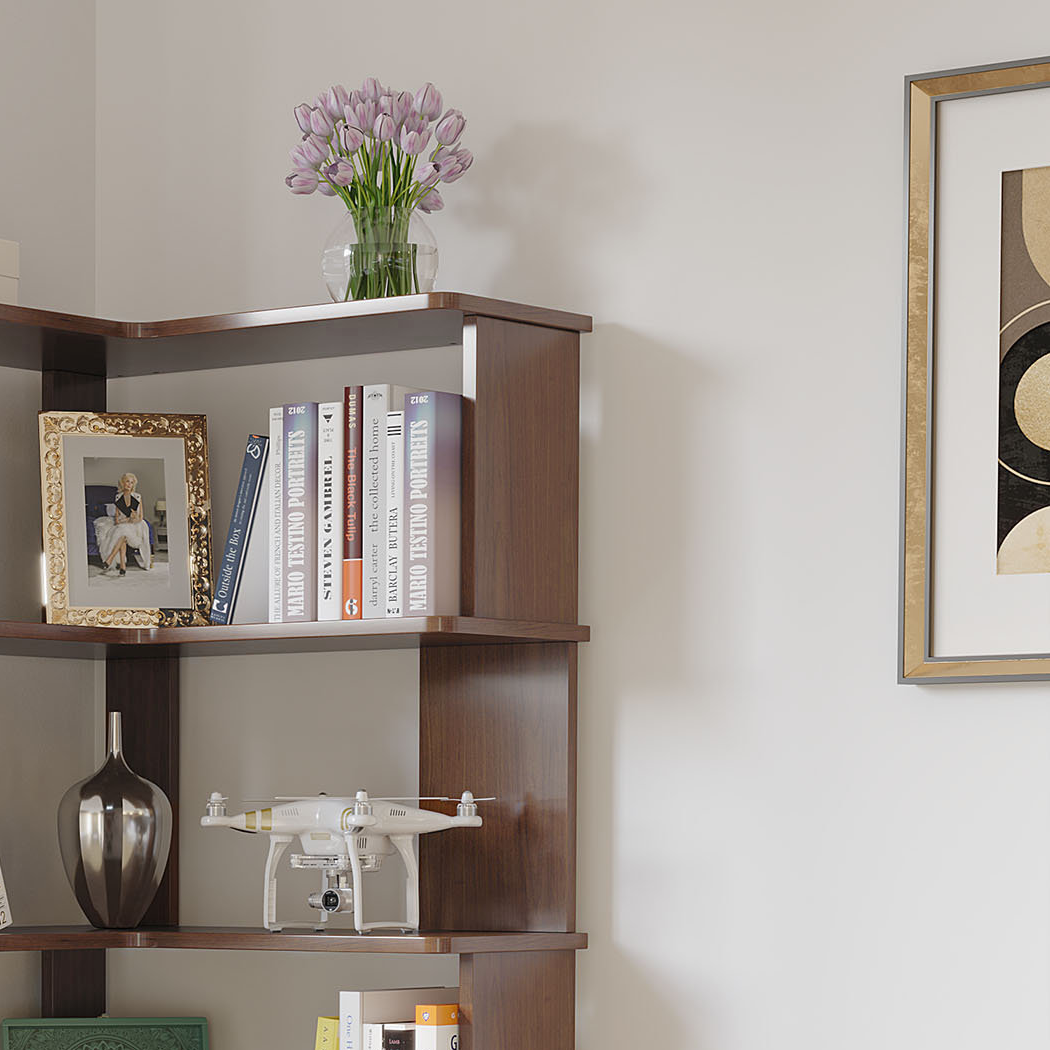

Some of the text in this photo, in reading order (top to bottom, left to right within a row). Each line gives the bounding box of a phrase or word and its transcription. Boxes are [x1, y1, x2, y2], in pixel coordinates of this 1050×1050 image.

[288, 406, 306, 414] 2012
[348, 394, 356, 428] DUMAS
[410, 395, 428, 404] 2012
[346, 448, 356, 542] The Black Tulip
[369, 418, 378, 607] darryl carter the collected home
[228, 528, 242, 546] Box
[287, 511, 305, 568] TESTINO
[322, 456, 333, 600] STEVEN GAMBREL
[388, 506, 398, 550] BUTERA
[409, 504, 428, 561] TESTINO
[224, 547, 238, 562] the
[217, 564, 234, 599] Outside
[287, 571, 305, 616] MARIO
[388, 556, 398, 602] BARCLAY
[409, 564, 428, 611] MARIO
